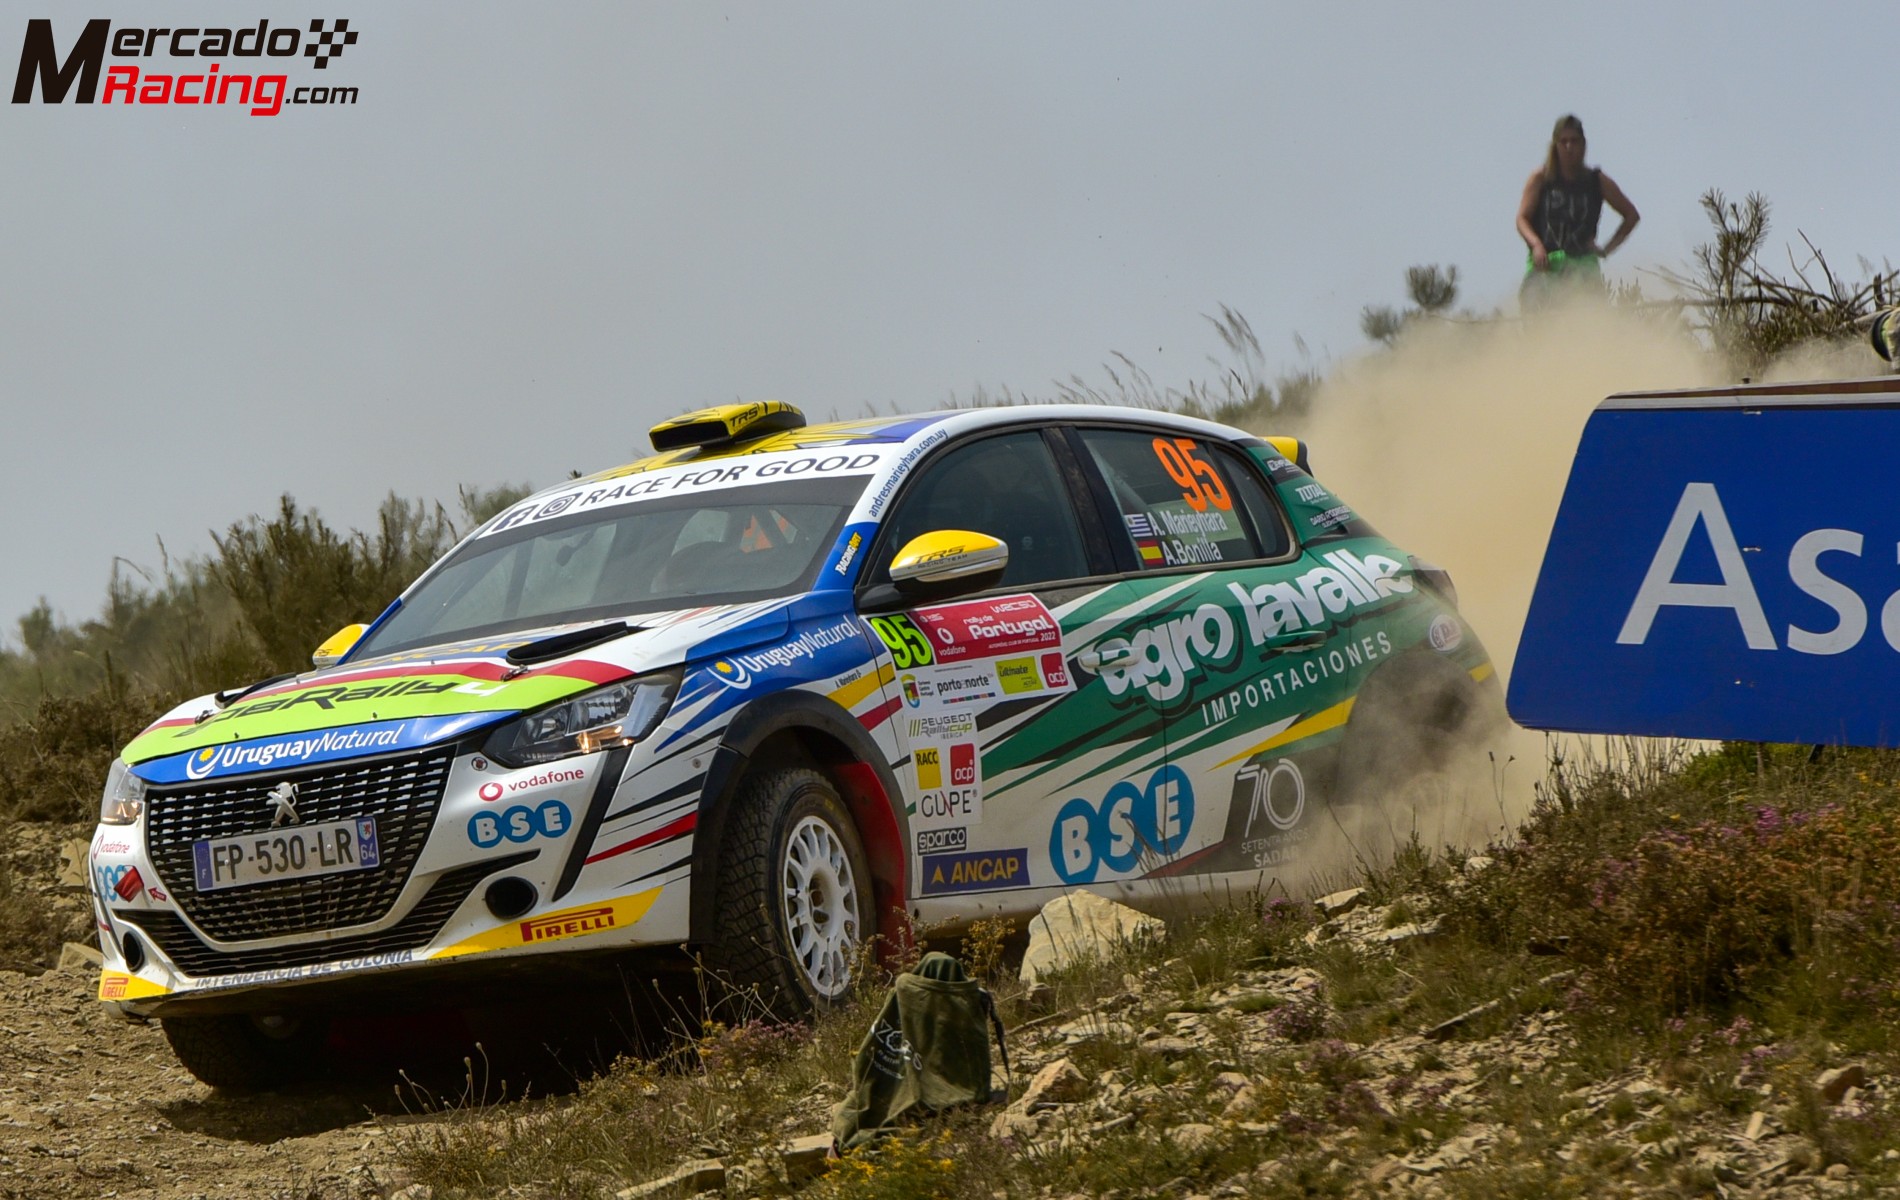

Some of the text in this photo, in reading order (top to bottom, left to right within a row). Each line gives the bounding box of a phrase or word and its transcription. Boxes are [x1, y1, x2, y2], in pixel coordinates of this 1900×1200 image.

[730, 406, 759, 428] TRS
[579, 453, 881, 508] RACE FOR GOOD
[1152, 436, 1232, 512] 95
[1295, 483, 1328, 503] TOTAL
[915, 545, 966, 564] TRS
[1615, 482, 1900, 656] As
[968, 614, 1054, 640] Portugal
[1040, 631, 1057, 642] 2022
[1098, 547, 1415, 702] agro lavalle
[870, 614, 934, 669] 95
[939, 646, 966, 656] vodafone
[937, 674, 990, 697] porto norte
[1048, 671, 1067, 685] acp
[1201, 630, 1393, 727] IMPORTACIONES
[921, 712, 973, 727] PEUGEOT
[222, 723, 403, 768] UruguayNatural
[915, 751, 939, 766] RACC
[508, 768, 586, 793] vodafone
[954, 766, 974, 782] acp
[1237, 757, 1306, 839] 70
[474, 804, 566, 846] BSE
[1060, 780, 1181, 877] BSE
[360, 842, 377, 861] 64
[918, 829, 966, 852] sparco
[950, 856, 1020, 884] ANCAP
[519, 906, 616, 943] PIRELLI
[338, 949, 414, 970] COLONIA
[101, 976, 129, 998] PIRELLI
